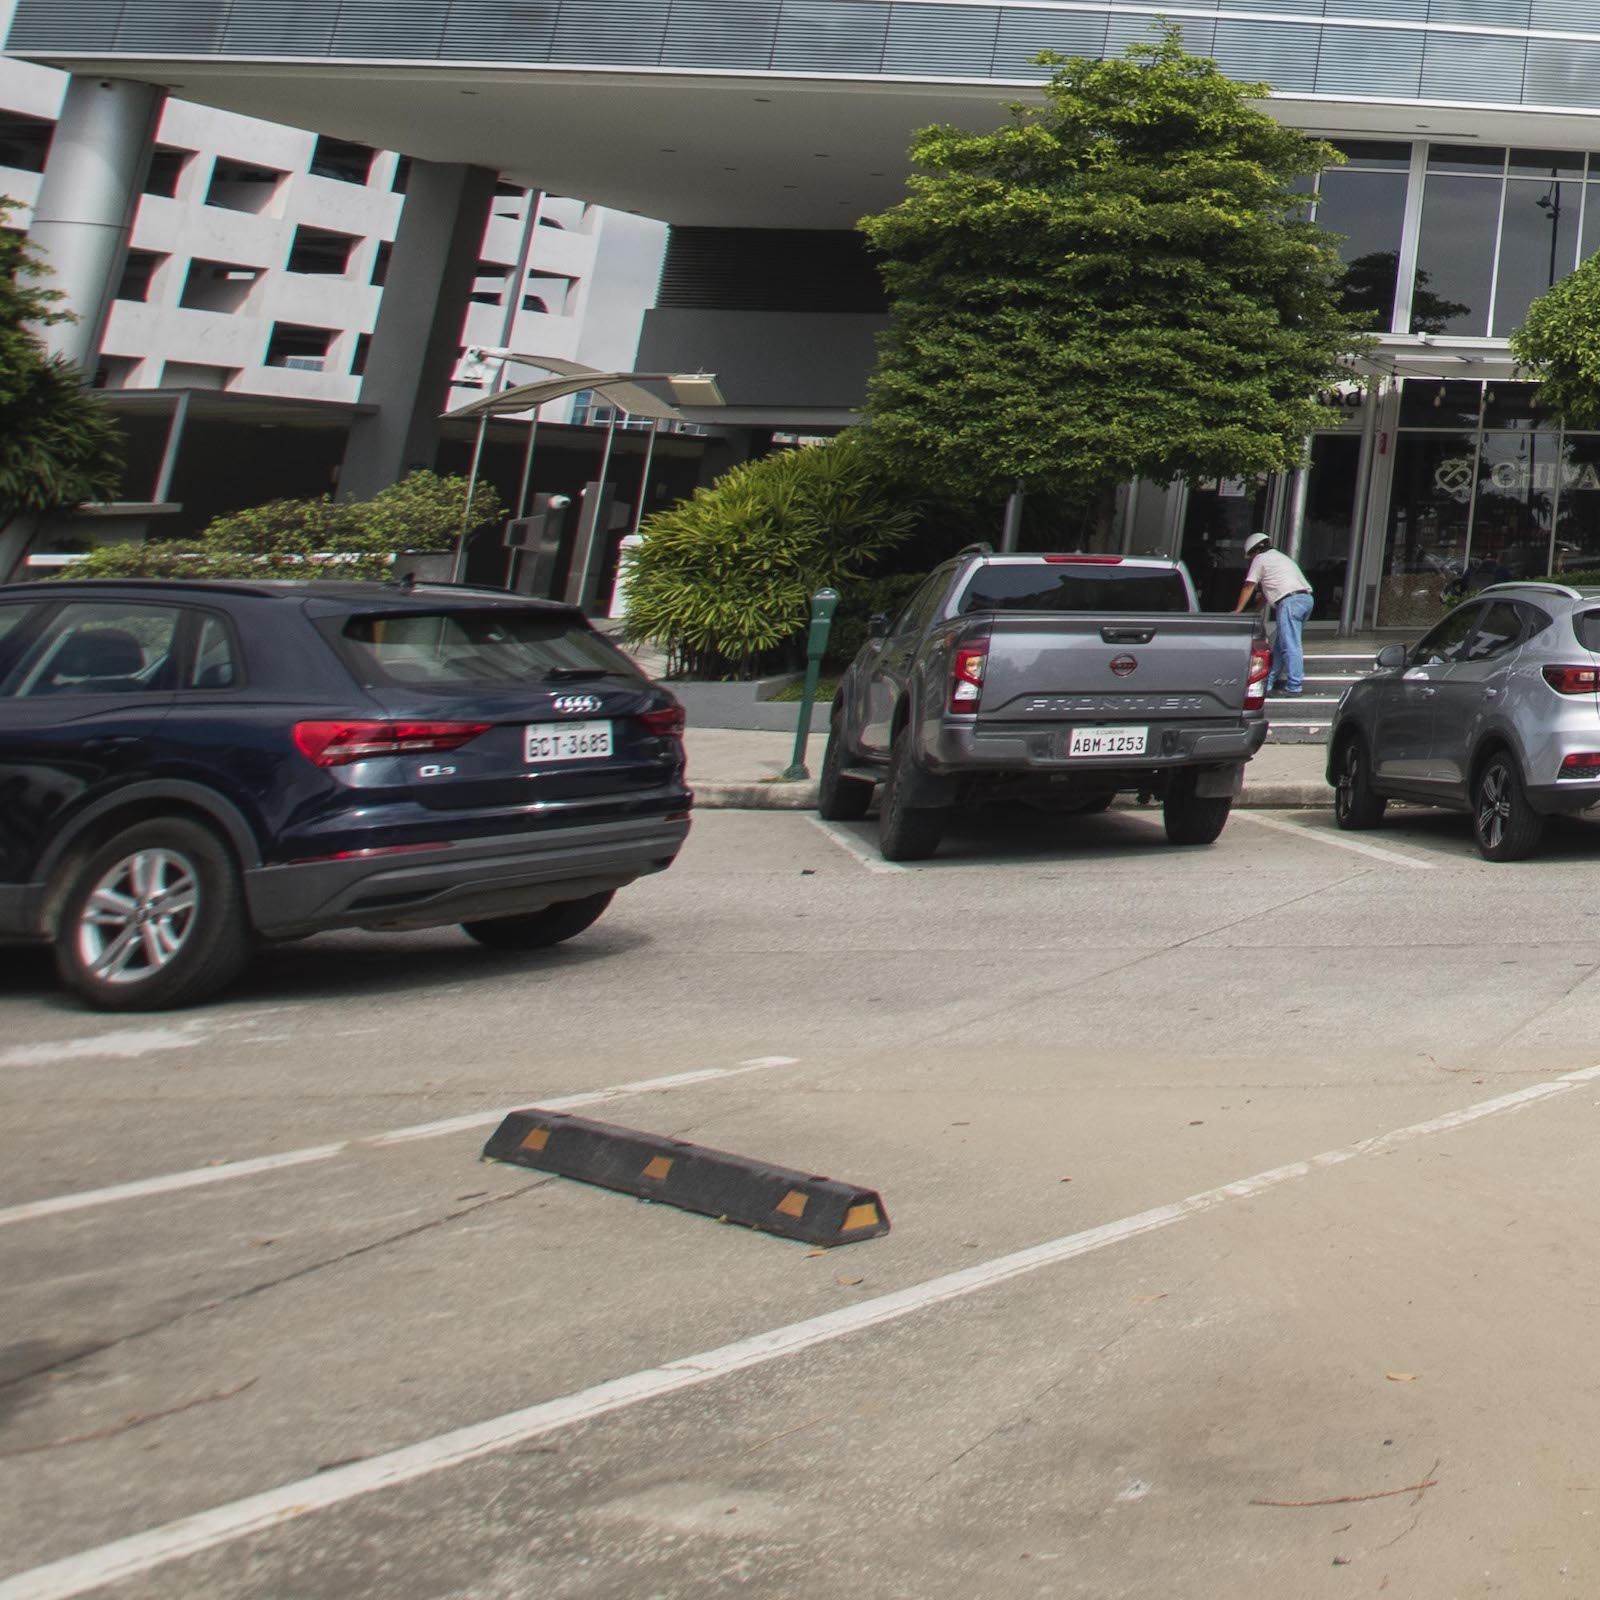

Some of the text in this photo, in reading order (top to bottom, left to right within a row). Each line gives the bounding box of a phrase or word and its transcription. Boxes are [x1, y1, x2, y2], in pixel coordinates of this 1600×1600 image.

[1025, 698, 1205, 712] FRONTIER
[528, 733, 609, 758] GCT-3685
[1073, 736, 1145, 753] ABM-1253
